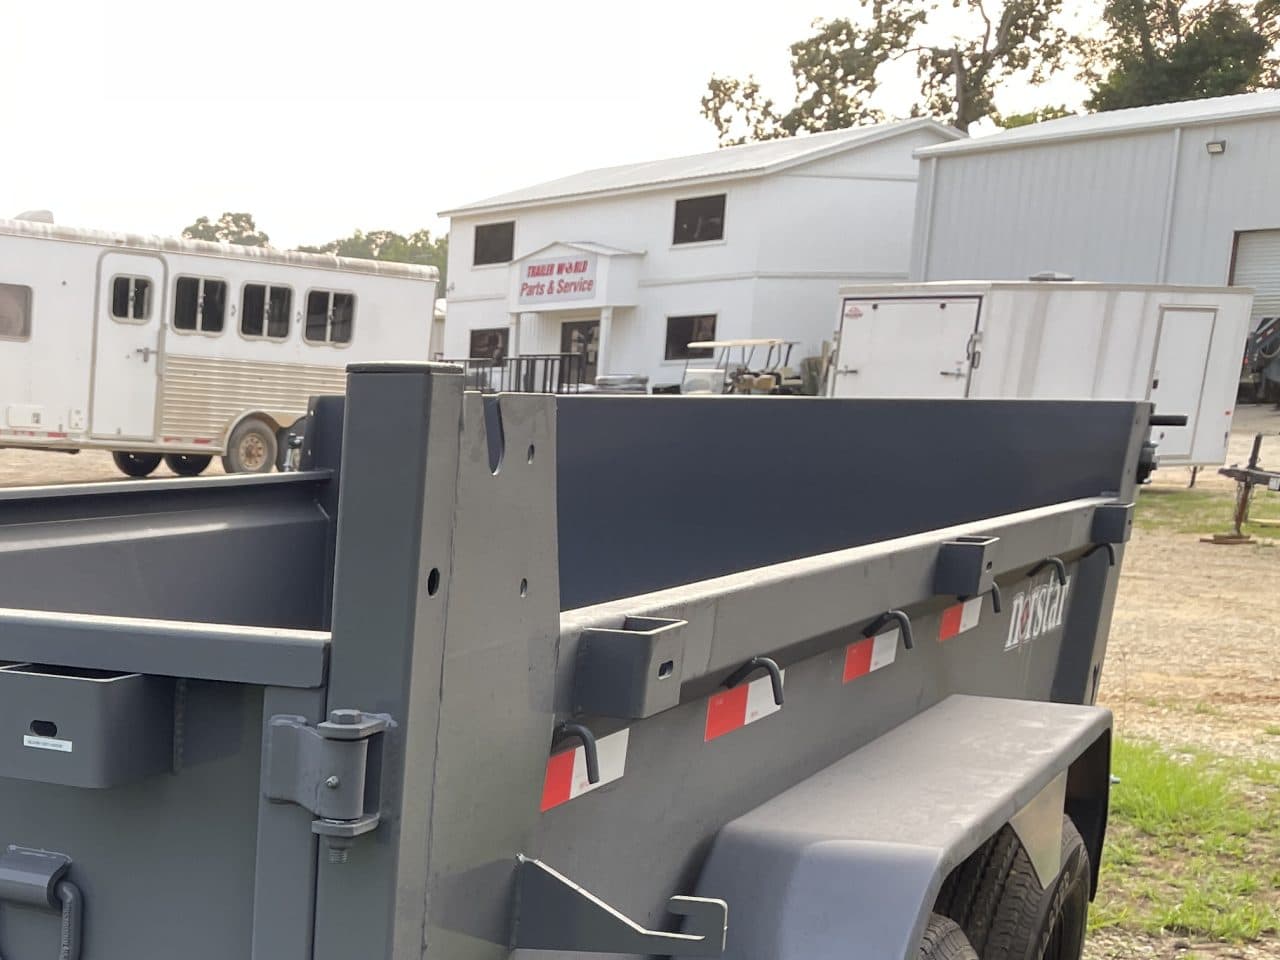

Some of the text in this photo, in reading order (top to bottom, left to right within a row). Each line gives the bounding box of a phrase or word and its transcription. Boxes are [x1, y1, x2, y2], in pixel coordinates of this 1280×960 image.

[528, 264, 556, 278] TRAILER
[521, 277, 593, 296] Parts & Service
